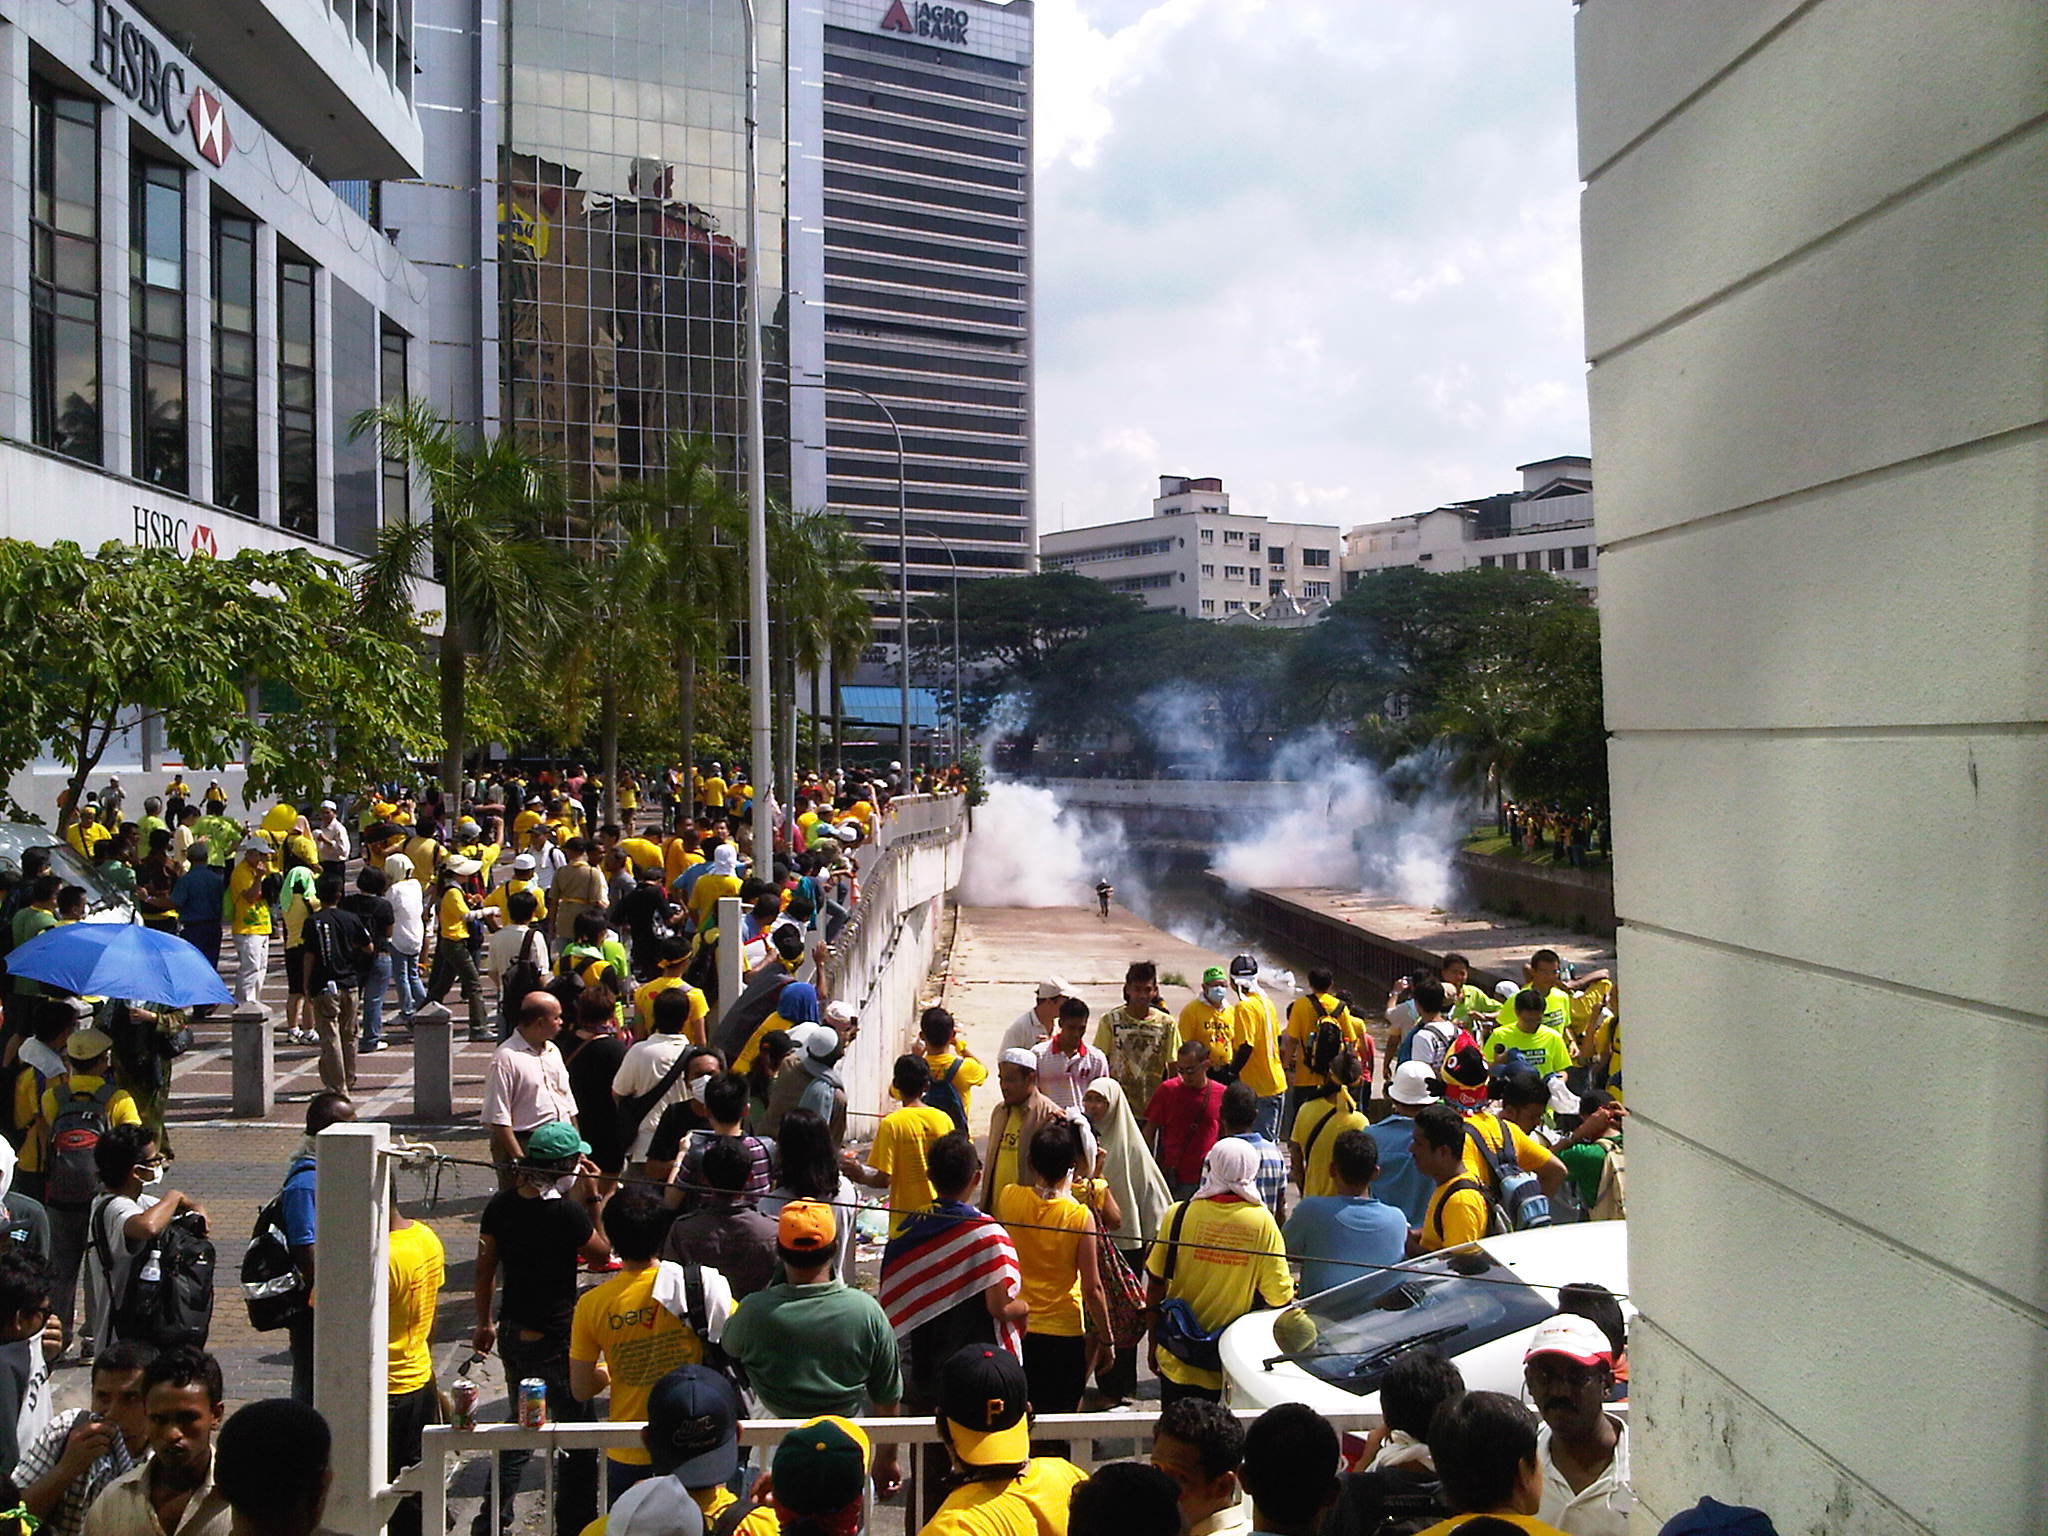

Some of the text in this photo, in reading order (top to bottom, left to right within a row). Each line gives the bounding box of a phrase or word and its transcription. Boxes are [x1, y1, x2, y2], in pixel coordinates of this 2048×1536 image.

[918, 2, 969, 28] AGRO
[918, 19, 968, 45] BANK
[90, 0, 185, 134] HSBC
[132, 505, 188, 561] HSBC
[986, 1398, 1005, 1425] P
